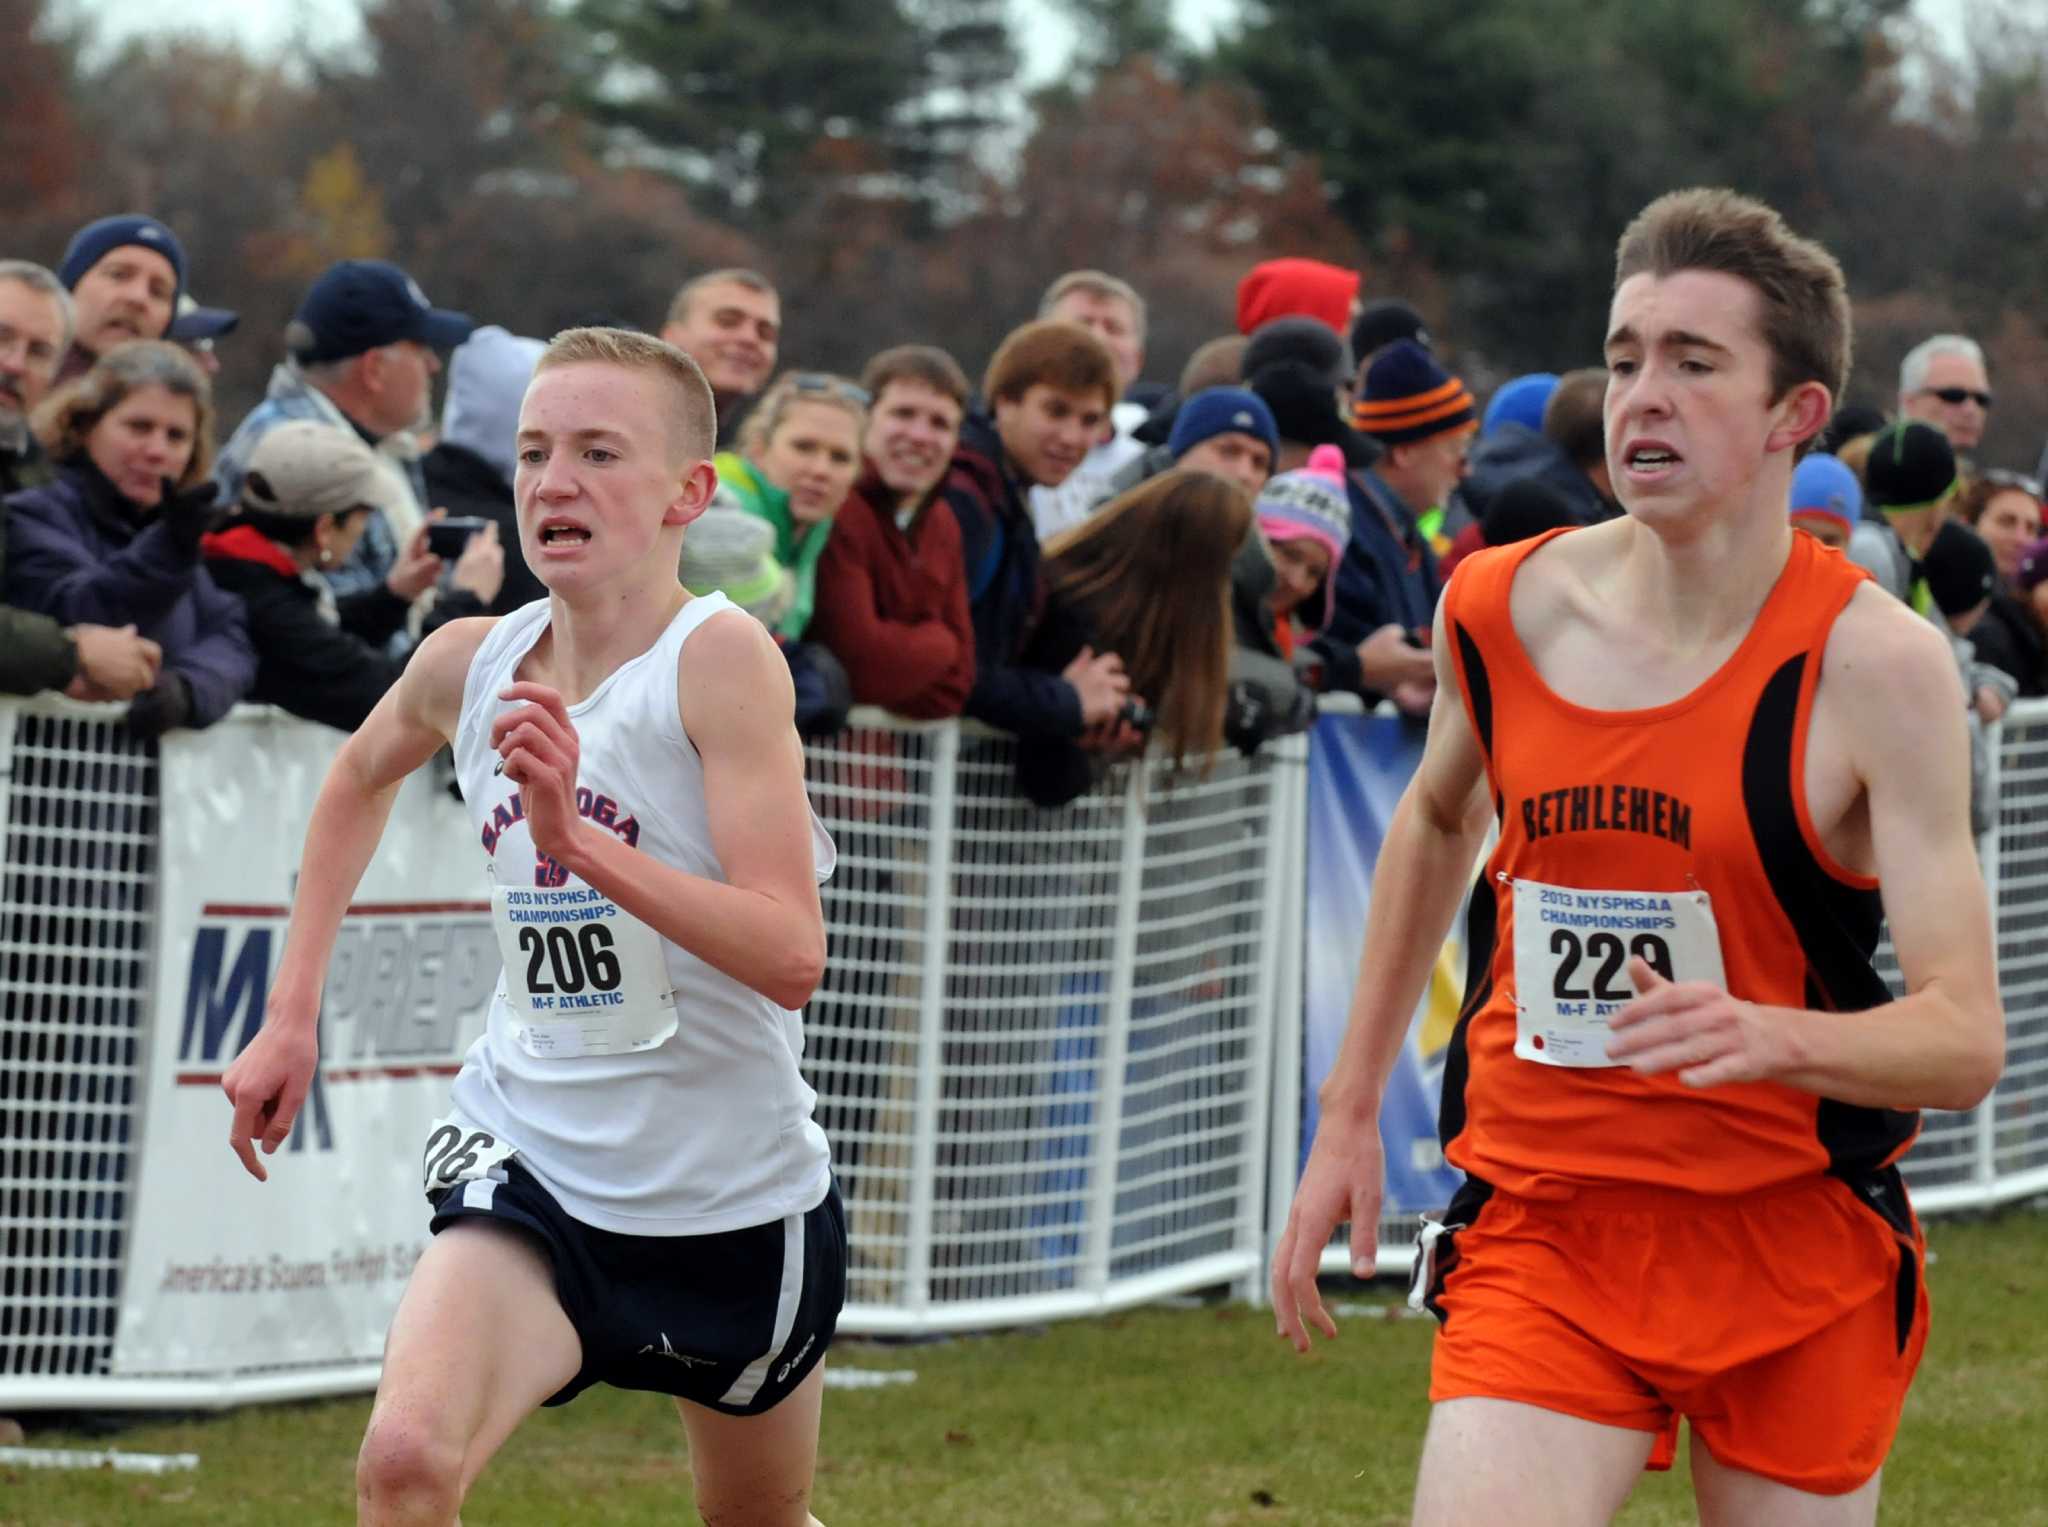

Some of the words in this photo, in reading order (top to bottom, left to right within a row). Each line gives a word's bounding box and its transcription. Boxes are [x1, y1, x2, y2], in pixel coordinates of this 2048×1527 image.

[481, 786, 641, 857] SAOGA
[1521, 784, 1692, 850] BETHLEHEM
[507, 892, 532, 904] 2013
[534, 888, 606, 905] NYSPHSA
[1540, 890, 1573, 908] 2013
[1577, 897, 1672, 912] NYSPHSAA
[509, 903, 617, 924] CHAMPIONSHIPS
[1540, 908, 1676, 930] CHAMPIONSHIPS
[519, 922, 622, 995] 206
[1550, 928, 1675, 1001] 229
[532, 996, 555, 1010] M-F
[559, 991, 625, 1010] ATHLETIC
[1556, 1002, 1588, 1016] M-F
